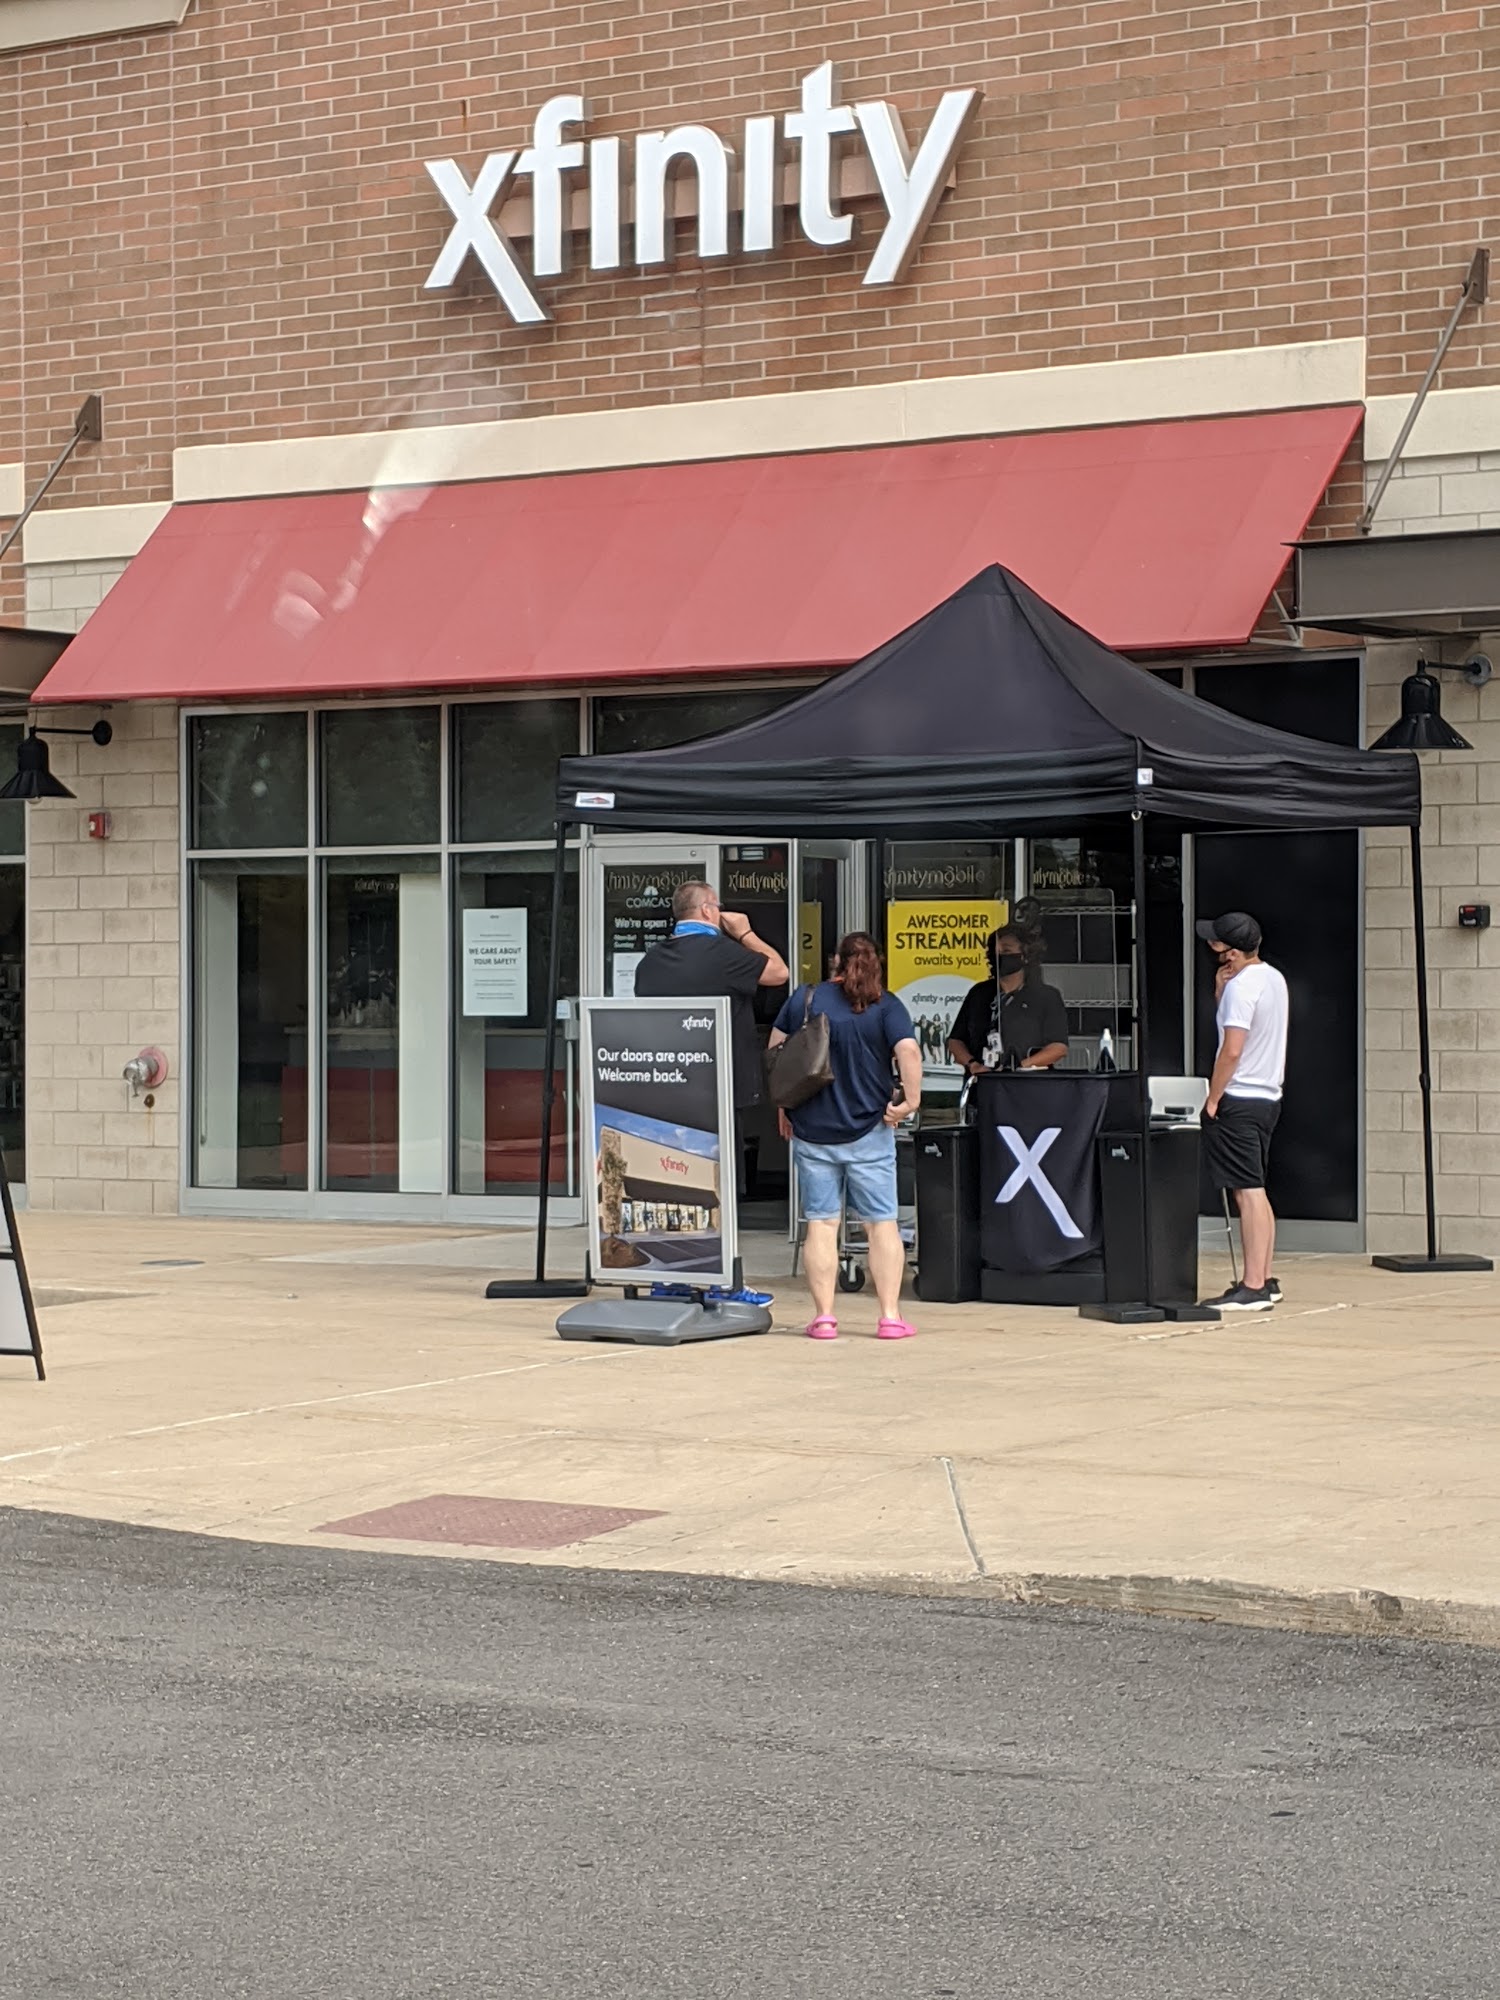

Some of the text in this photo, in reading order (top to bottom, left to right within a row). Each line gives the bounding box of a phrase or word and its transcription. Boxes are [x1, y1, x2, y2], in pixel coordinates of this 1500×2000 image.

[423, 59, 980, 323] xfinity
[625, 897, 674, 909] COMCAS
[643, 919, 667, 930] open
[906, 914, 989, 929] AWESOMER
[895, 931, 987, 950] STREAMIN
[480, 947, 498, 955] CARE
[499, 947, 521, 955] ABOUT
[493, 958, 517, 966] SAFETY
[914, 952, 981, 969] awaits you!
[911, 992, 938, 1005] xfinity
[682, 1015, 714, 1030] xfinity
[597, 1047, 714, 1066] Our doors are open.
[598, 1067, 687, 1083] Welcome back.
